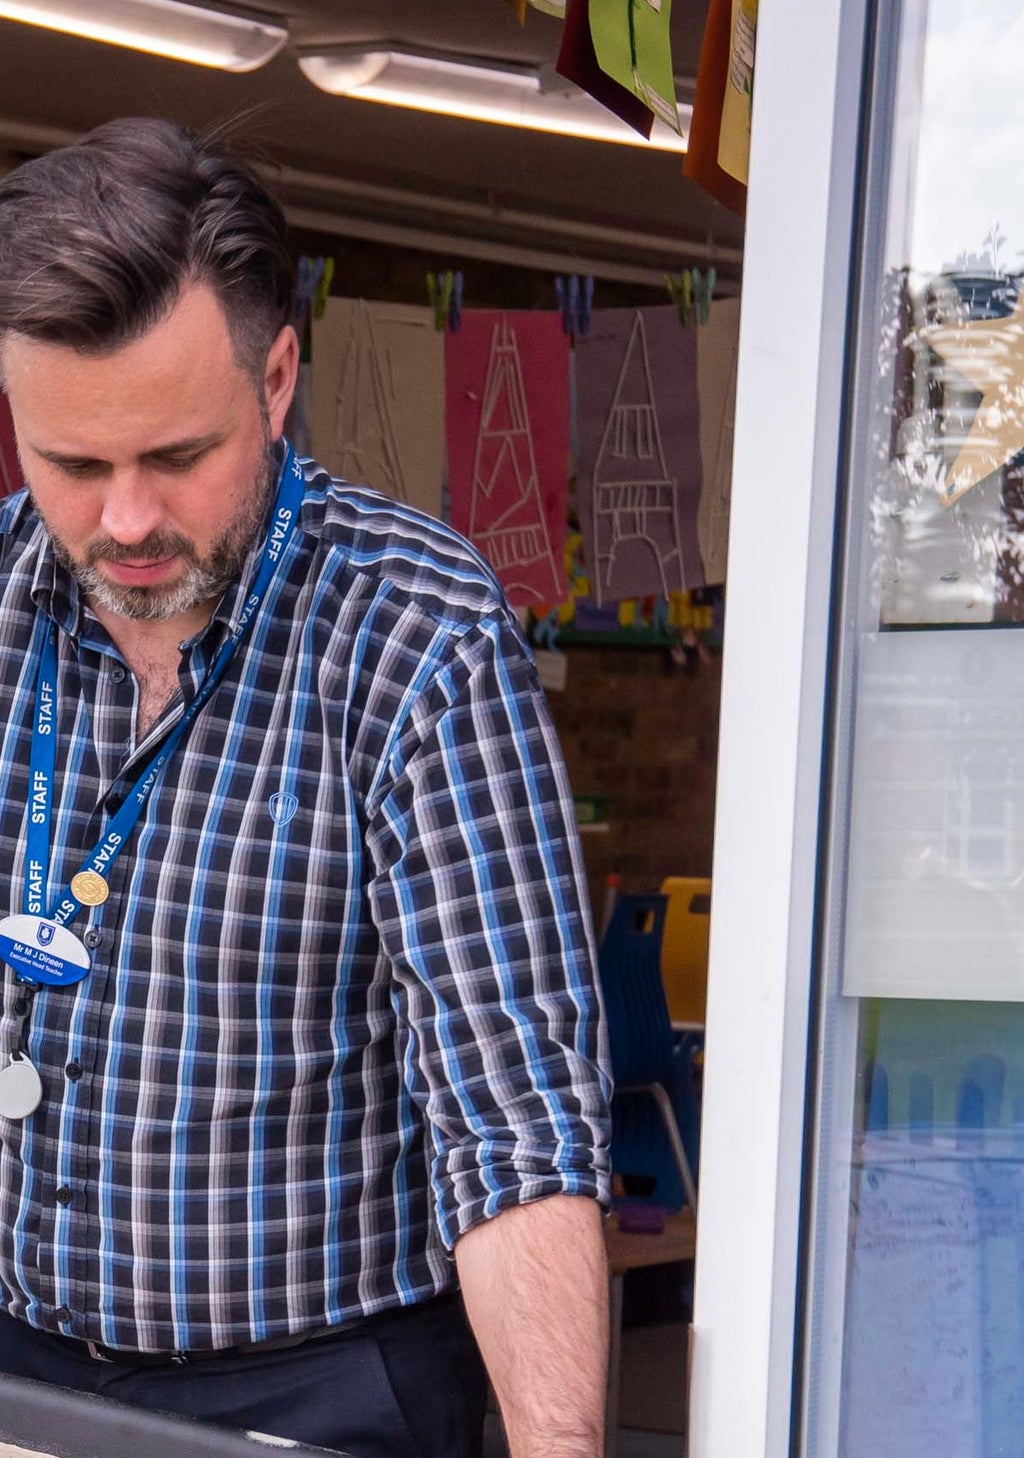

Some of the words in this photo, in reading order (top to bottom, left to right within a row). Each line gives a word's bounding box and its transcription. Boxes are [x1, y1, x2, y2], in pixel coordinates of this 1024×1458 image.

[267, 507, 292, 562] STAFF
[231, 593, 260, 645] STAFF
[38, 681, 53, 735] STAFF
[32, 770, 48, 824] STAFF
[88, 832, 121, 875] STAF
[29, 860, 43, 913] STAFF
[13, 943, 24, 952] Mr
[24, 947, 33, 956] M
[38, 953, 64, 969] Dineen
